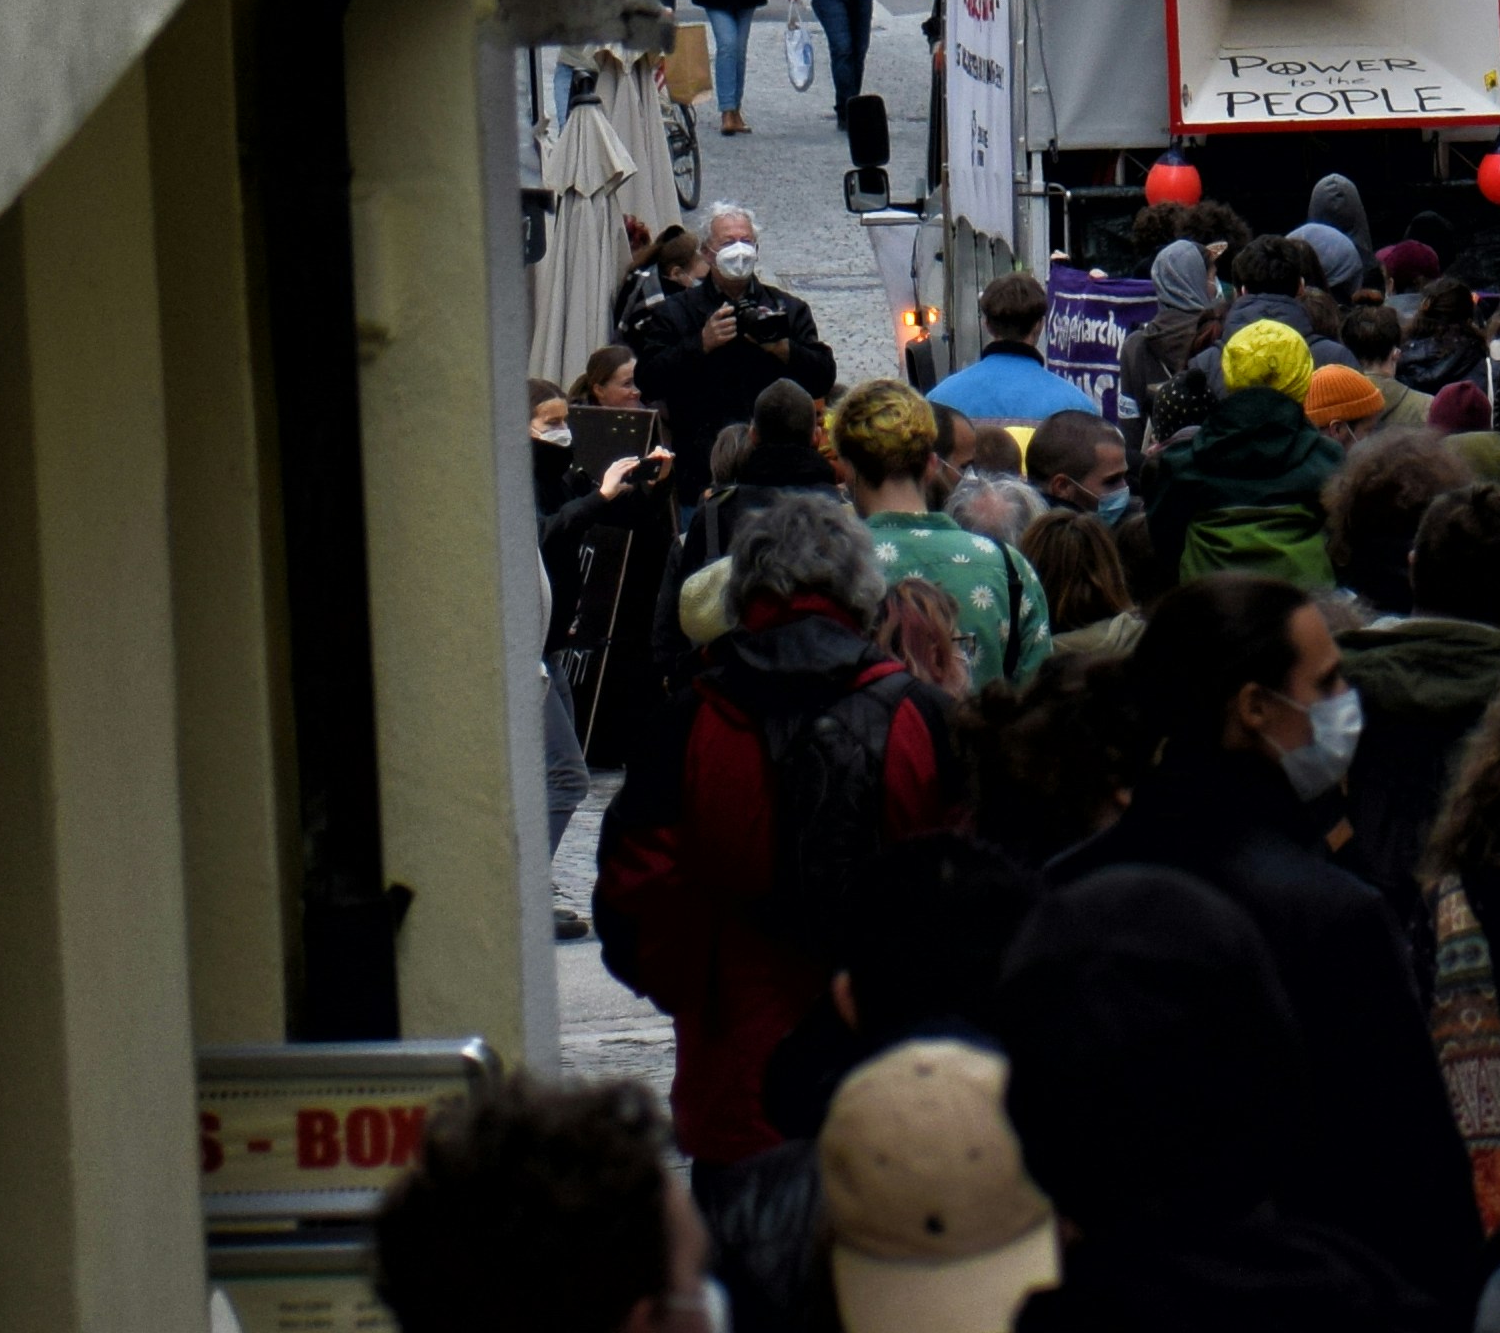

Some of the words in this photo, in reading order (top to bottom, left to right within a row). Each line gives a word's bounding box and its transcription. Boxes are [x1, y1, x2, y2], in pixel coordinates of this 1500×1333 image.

[1219, 55, 1426, 78] POWER
[1288, 78, 1316, 87] to
[1328, 75, 1370, 85] the
[1217, 86, 1466, 118] PEOPLE
[295, 1105, 428, 1170] BOX
